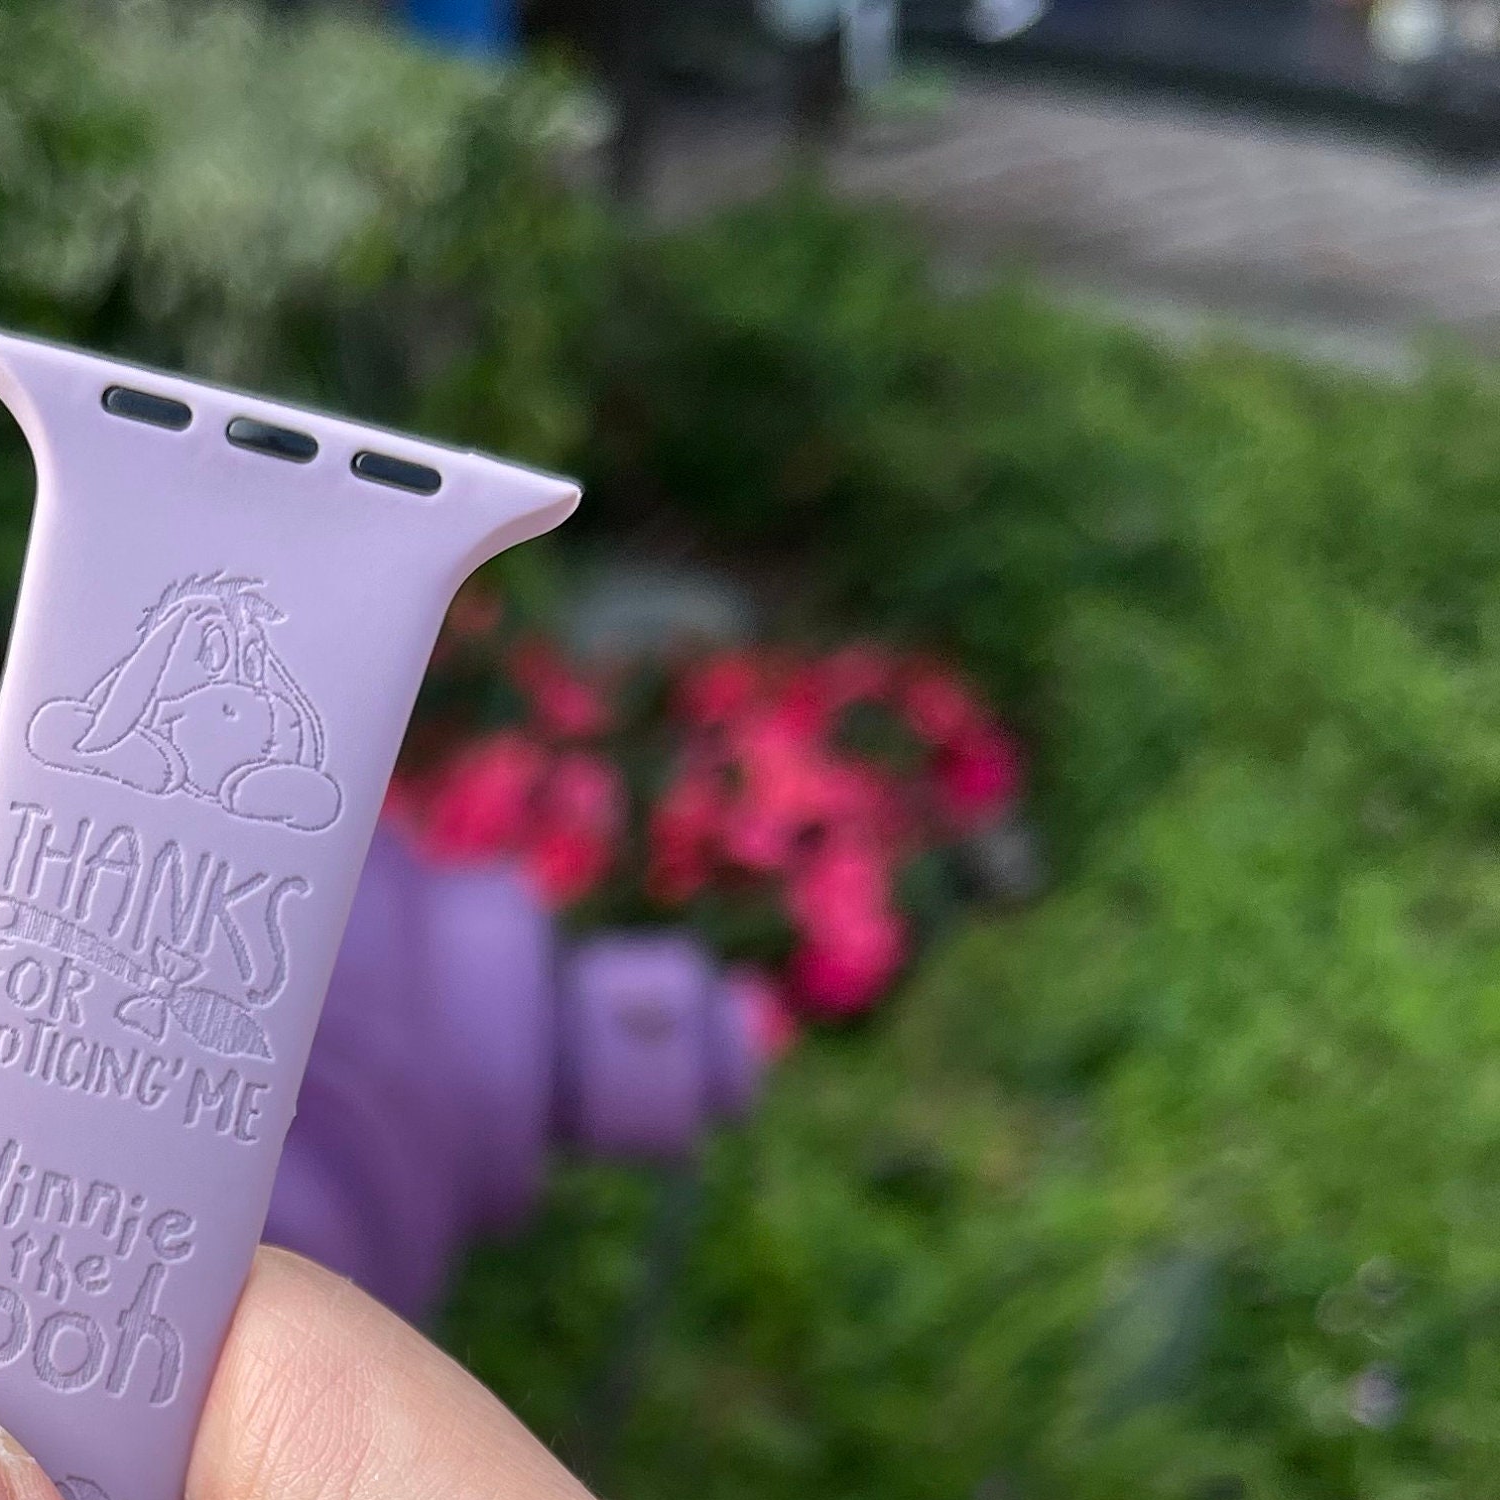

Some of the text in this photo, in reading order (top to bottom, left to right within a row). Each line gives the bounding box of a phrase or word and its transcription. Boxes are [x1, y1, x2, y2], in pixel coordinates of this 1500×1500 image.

[3, 801, 313, 1008] THANKS
[183, 1069, 271, 1145] ME
[10, 1231, 112, 1304] the
